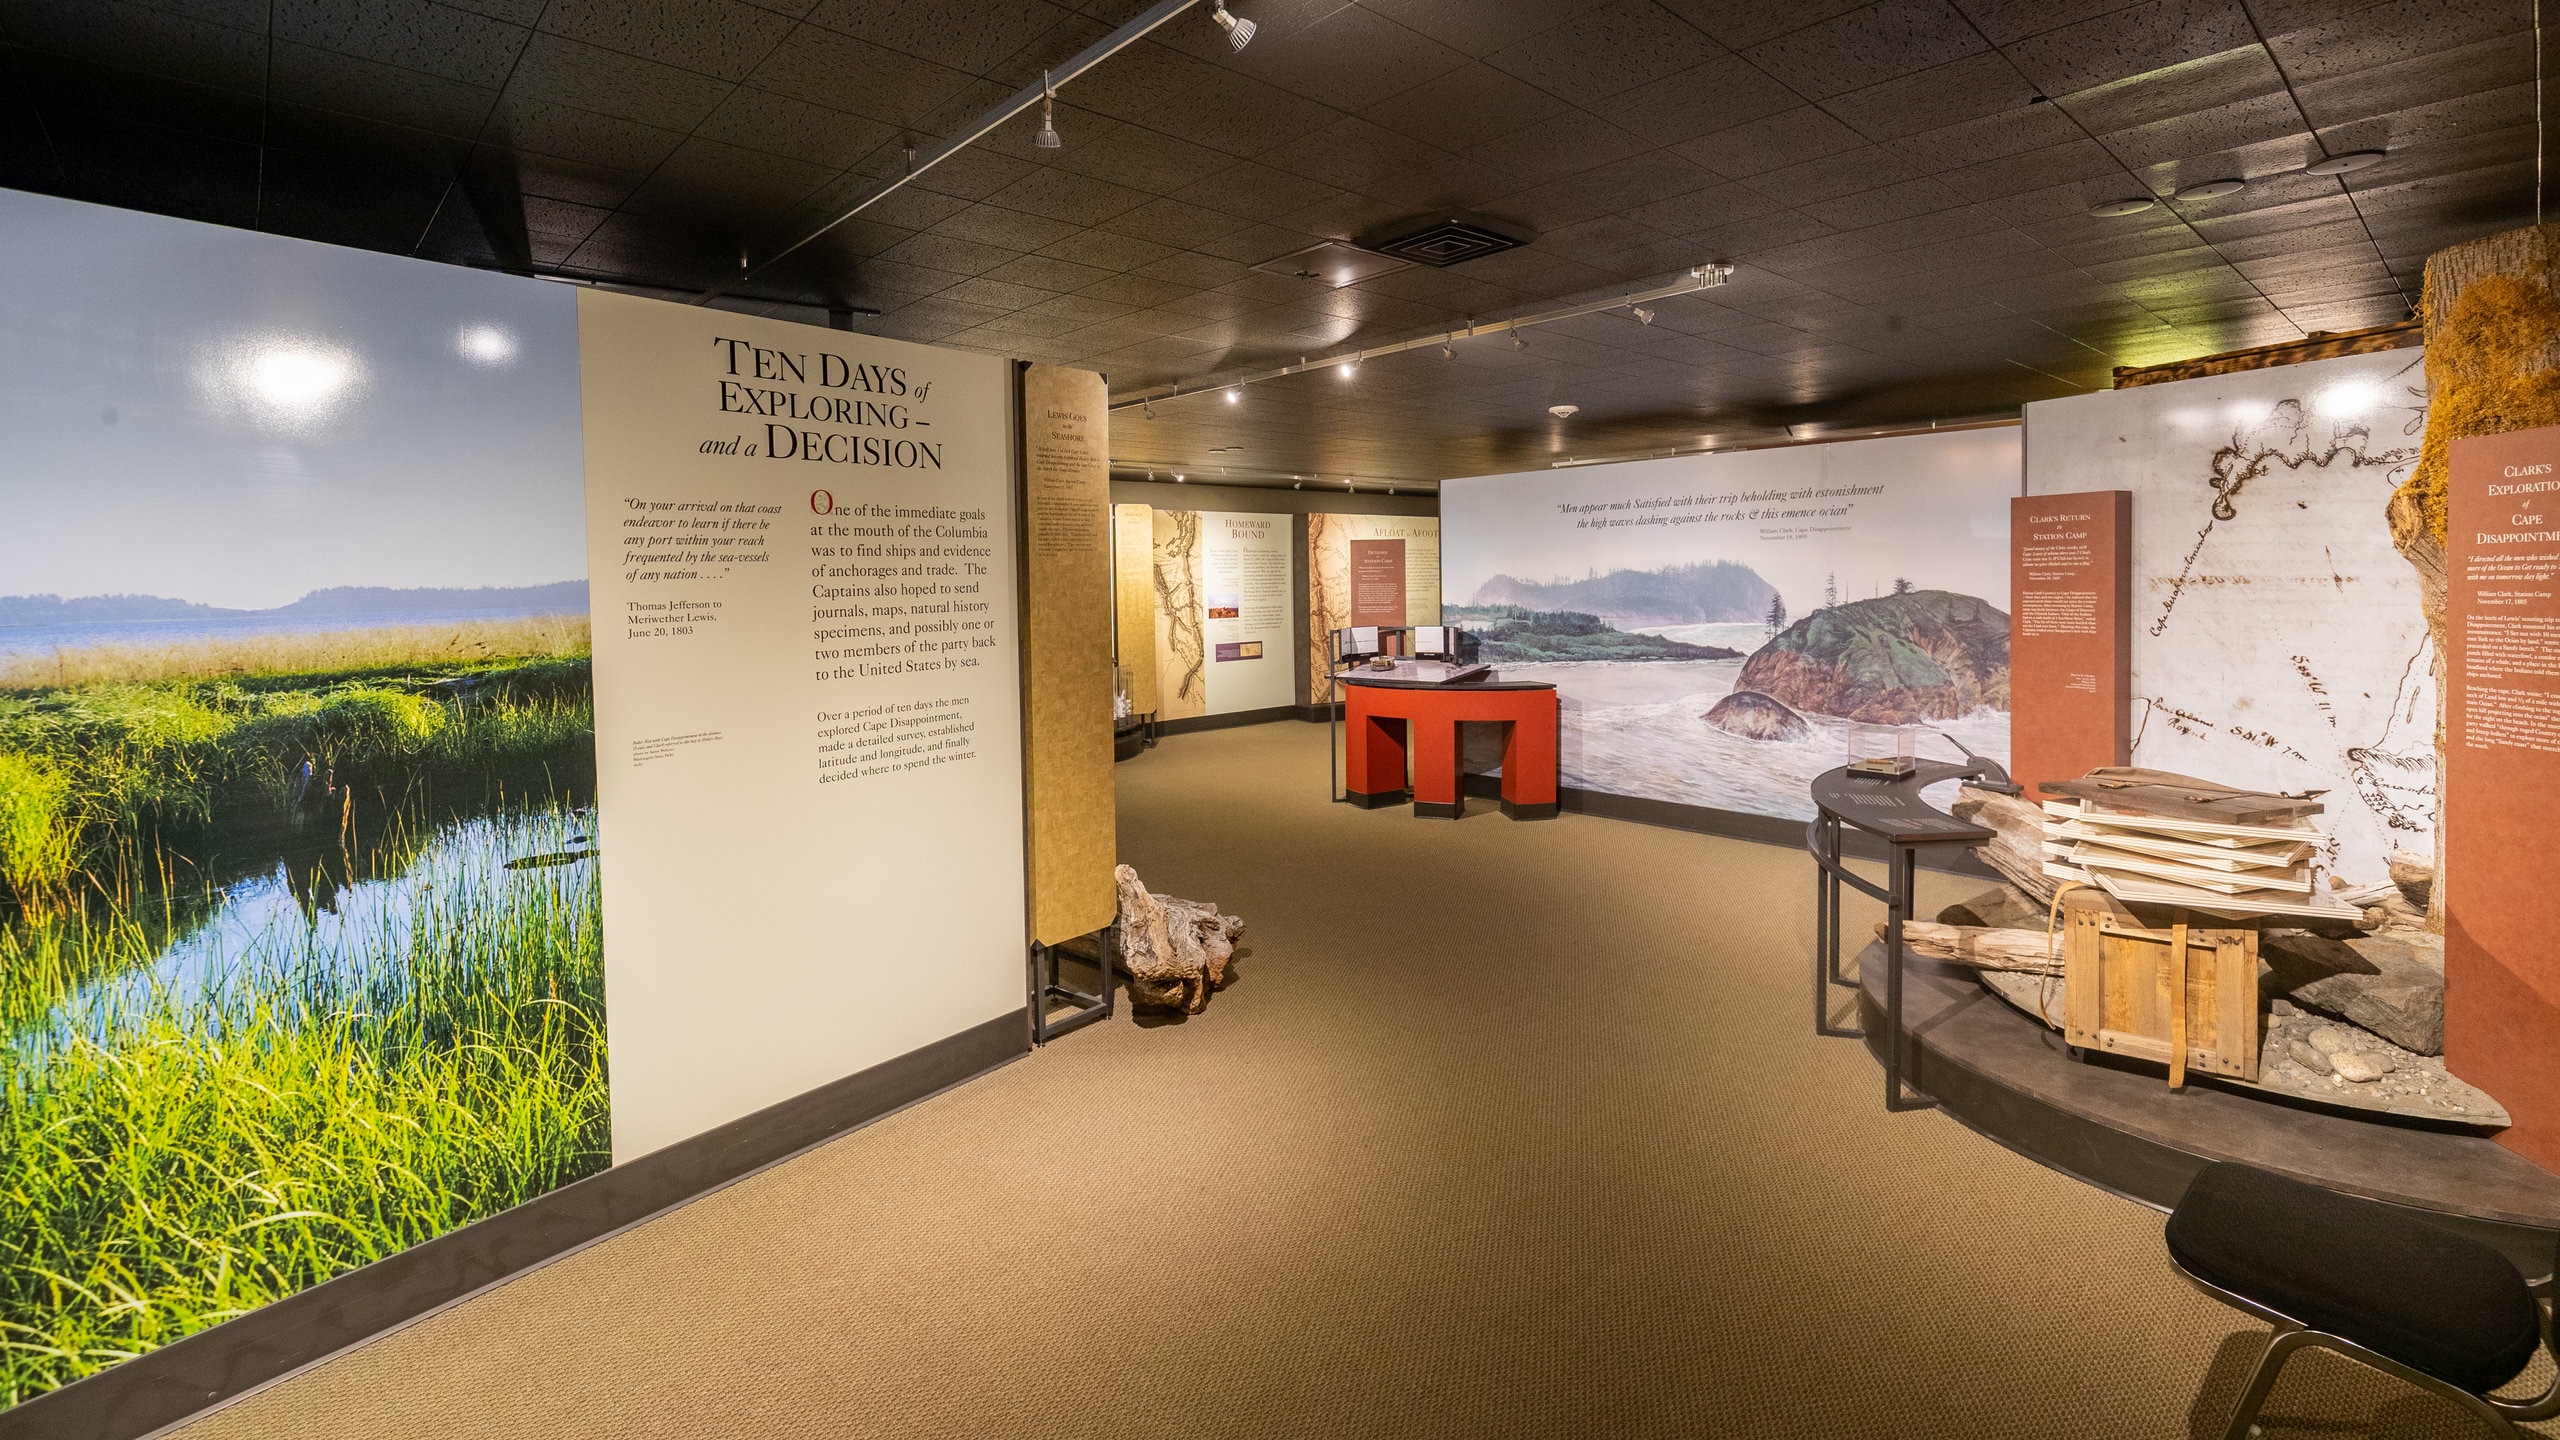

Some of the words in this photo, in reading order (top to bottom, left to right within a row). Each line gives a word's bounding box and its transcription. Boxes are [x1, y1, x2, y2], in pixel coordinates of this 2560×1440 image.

[714, 337, 806, 383] TEN
[819, 353, 906, 396] DAYS
[915, 382, 932, 403] of
[718, 381, 908, 429] EXPLORING
[1048, 410, 1068, 419] LEWIS
[1069, 413, 1087, 422] GOES
[1052, 432, 1085, 442] SEASHORE
[700, 436, 741, 455] and
[744, 444, 757, 456] a
[765, 424, 942, 470] DECISION
[2503, 463, 2552, 478] CLARK’S
[624, 497, 647, 510] “On
[648, 501, 677, 513] your
[677, 500, 719, 512] arrival
[719, 504, 733, 513] on
[734, 501, 756, 513] that
[757, 505, 783, 515] coast
[810, 489, 851, 517] One
[854, 503, 869, 517] of
[871, 503, 891, 518] the
[895, 504, 957, 520] immediate
[959, 507, 986, 523] goals
[1556, 503, 1578, 514] “Men
[1578, 503, 1609, 515] appear
[1609, 499, 1632, 511] much
[1633, 496, 1673, 511] Satisfied
[1673, 495, 1693, 507] with
[1694, 493, 1718, 506] their
[1718, 492, 1739, 507] trip
[1739, 489, 1789, 504] beholding
[1789, 486, 1813, 500] with
[1814, 483, 1885, 499] estonishment
[2521, 499, 2531, 510] of
[623, 515, 676, 528] endeavor
[677, 519, 689, 529] to
[691, 517, 719, 529] learn
[721, 517, 732, 532] if
[731, 517, 758, 530] there
[758, 518, 771, 530] be
[1226, 520, 1270, 528] HOMEWARD
[1576, 518, 1589, 529] the
[1589, 516, 1608, 531] high
[1608, 518, 1635, 527] waves
[1635, 513, 1669, 527] dashing
[1669, 512, 1703, 527] against
[1703, 511, 1719, 523] the
[1720, 509, 1746, 522] rocks
[1748, 508, 1760, 521] &
[1760, 507, 1780, 520] this
[1780, 509, 1817, 519] emence
[1818, 503, 1855, 517] ocian”
[2511, 513, 2543, 526] CAPE
[810, 526, 824, 536] at
[827, 522, 850, 537] the
[853, 523, 895, 537] mouth
[897, 524, 911, 538] of
[913, 524, 933, 538] the
[935, 525, 988, 539] Columbia
[1232, 529, 1264, 539] BOUND
[1374, 528, 1405, 537] AFLOAT
[1412, 529, 1438, 538] AFOOT
[623, 536, 645, 549] any
[646, 535, 673, 549] port
[675, 533, 709, 546] within
[710, 537, 736, 549] your
[737, 534, 765, 546] reach
[621, 550, 685, 566] frequented
[685, 550, 699, 566] by
[700, 550, 717, 563] the
[717, 551, 770, 563] sea-vessels
[810, 547, 836, 557] was
[839, 547, 853, 557] to
[857, 543, 882, 557] find
[885, 543, 917, 560] ships
[919, 544, 940, 557] and
[943, 544, 991, 557] evidence
[626, 569, 639, 583] of
[640, 572, 660, 582] any
[663, 568, 697, 580] nation
[811, 563, 827, 578] of
[828, 563, 898, 580] anchorages
[901, 563, 923, 577] and
[926, 563, 959, 576] trade.
[963, 562, 987, 575] The
[626, 601, 667, 612] Thomas
[668, 600, 711, 612] Jefferson
[712, 601, 723, 609] to
[627, 613, 685, 625] Meriwether
[687, 612, 717, 622] Lewis,
[627, 628, 651, 640] June
[653, 627, 669, 637] 20,
[671, 625, 694, 636] 1803
[817, 711, 843, 723] Over
[844, 711, 850, 719] a
[852, 704, 883, 721] period
[884, 703, 896, 714] of
[897, 704, 912, 713] ten
[913, 700, 933, 712] days
[935, 697, 950, 708] the
[951, 697, 970, 706] men
[817, 722, 861, 739] explored
[862, 721, 888, 733] Cape
[889, 711, 963, 729] Disappointment,
